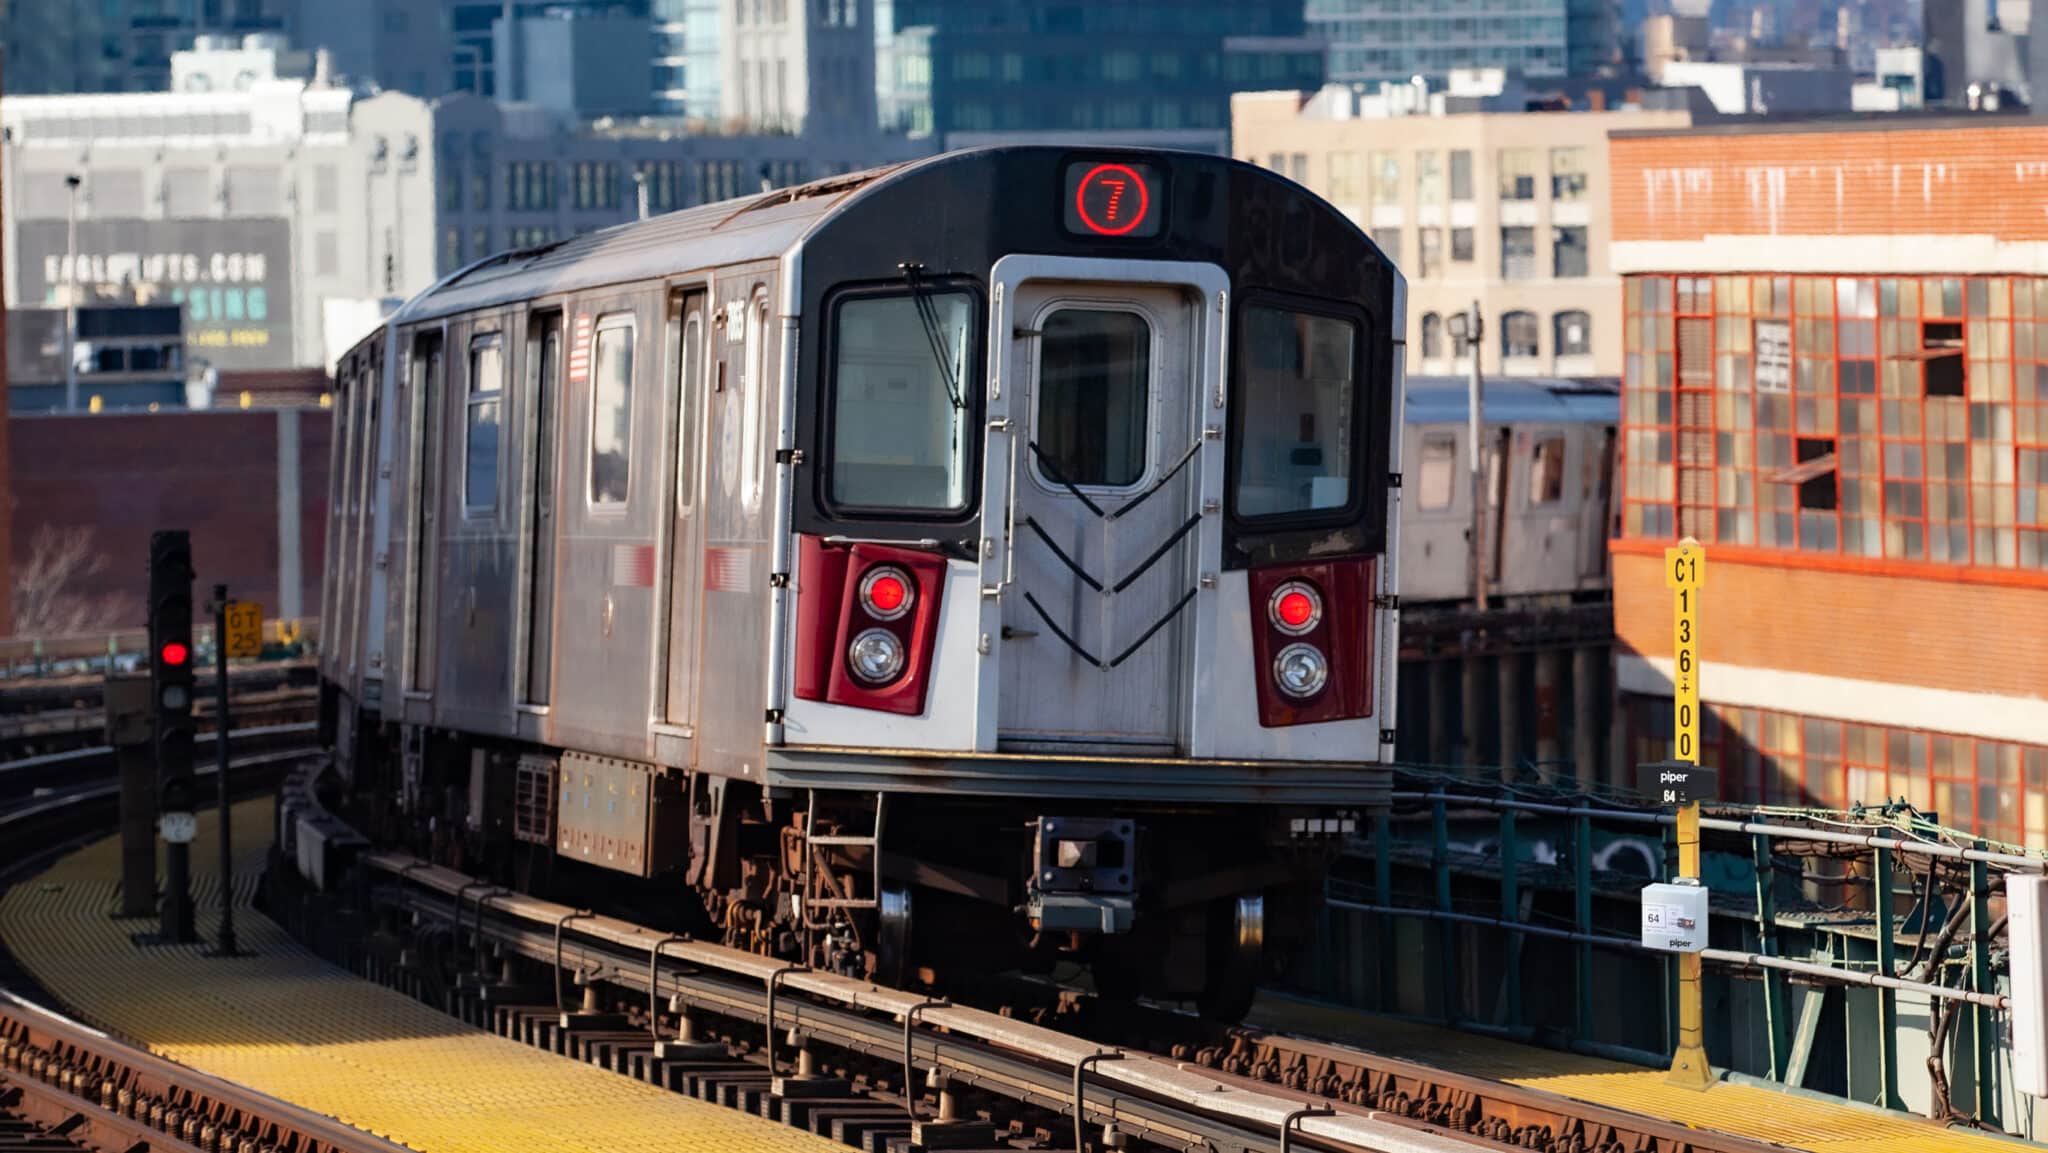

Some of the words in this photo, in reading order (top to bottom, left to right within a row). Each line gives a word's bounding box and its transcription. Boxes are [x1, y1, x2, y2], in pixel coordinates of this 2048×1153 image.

[1100, 179, 1126, 221] 7
[232, 632, 257, 649] 25
[1660, 769, 1689, 785] piper
[1663, 789, 1676, 803] 64
[1647, 913, 1660, 923] 64
[1669, 938, 1692, 948] piper
